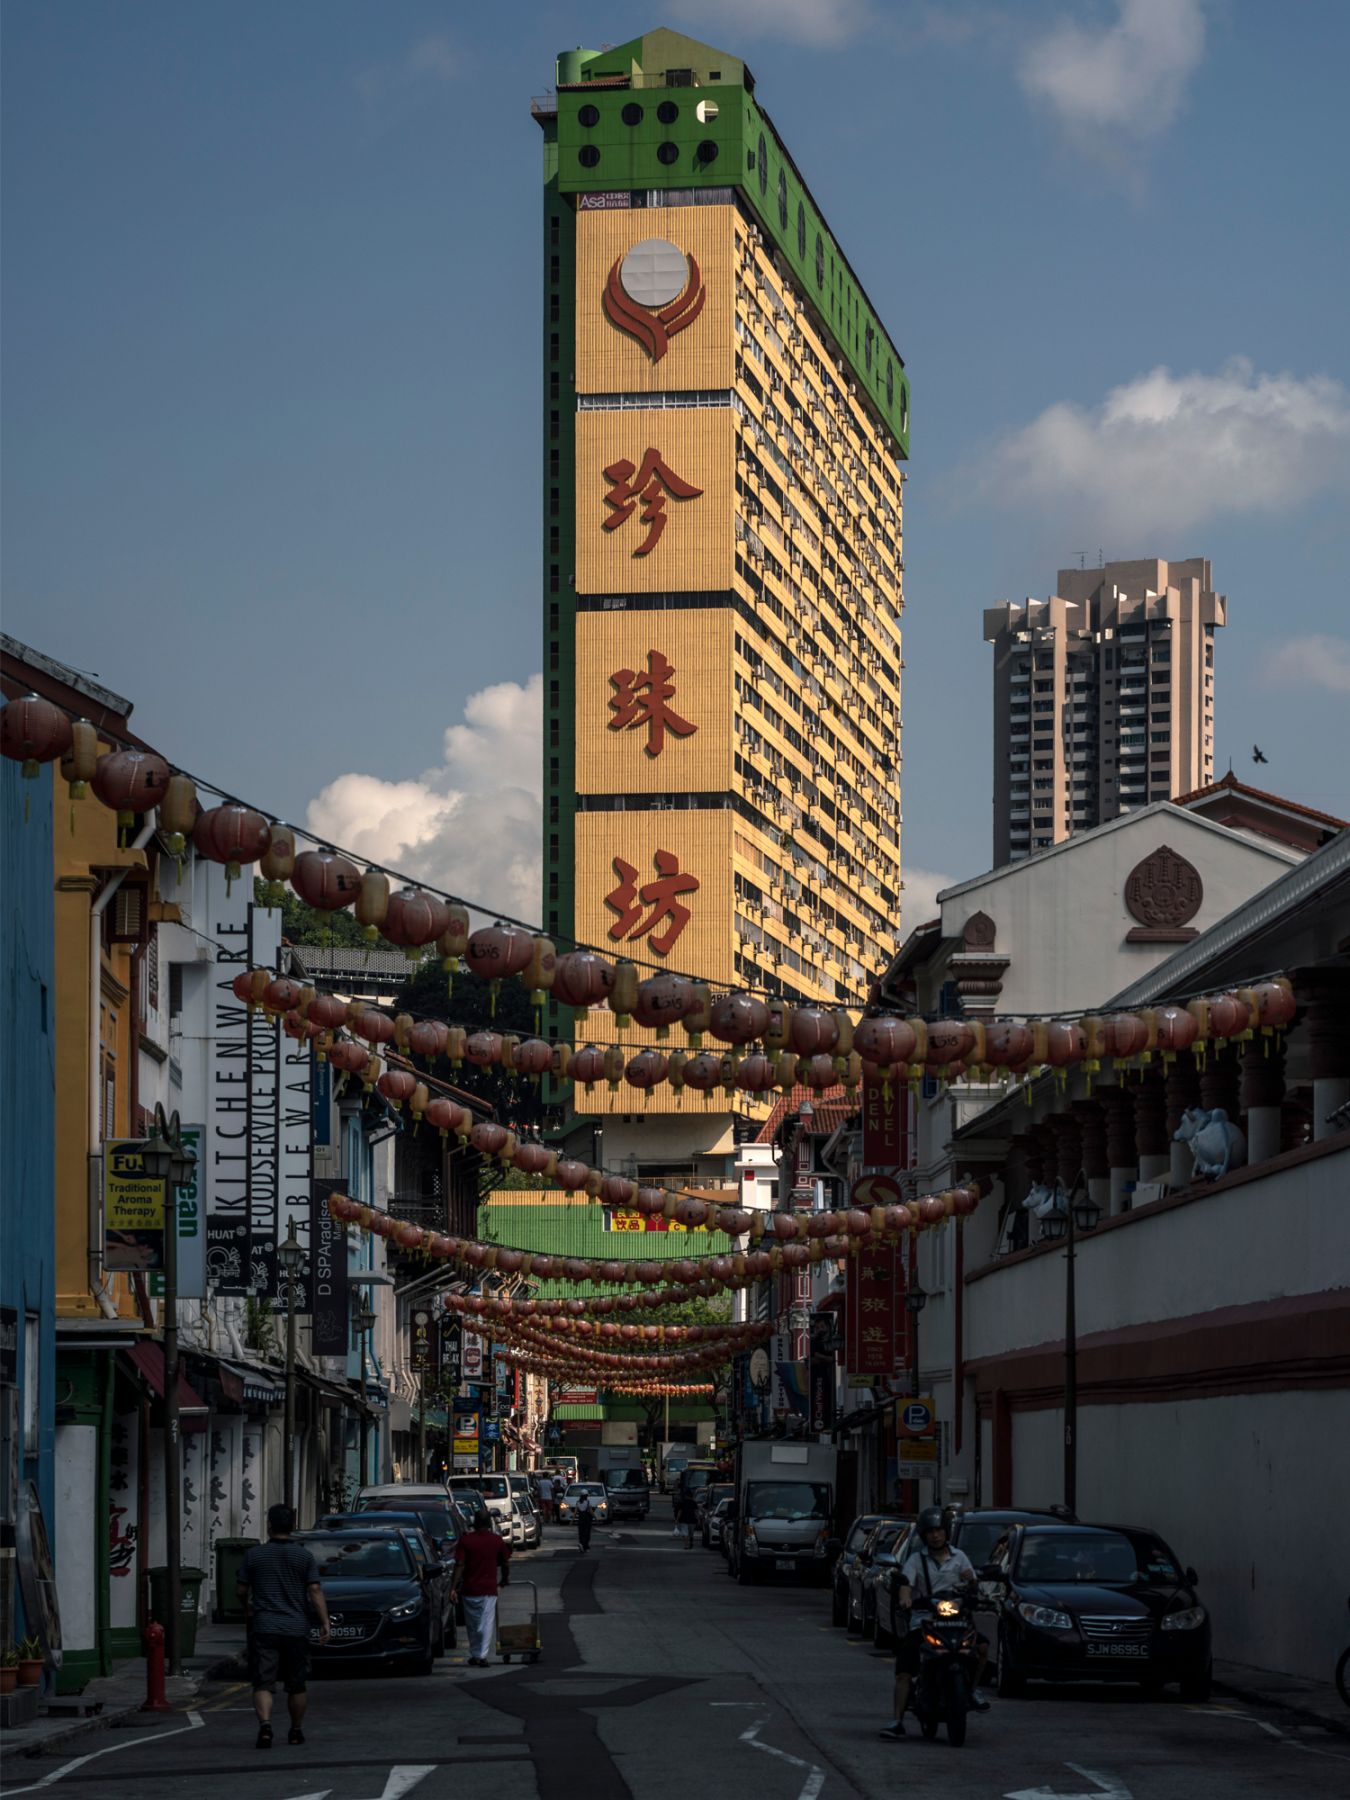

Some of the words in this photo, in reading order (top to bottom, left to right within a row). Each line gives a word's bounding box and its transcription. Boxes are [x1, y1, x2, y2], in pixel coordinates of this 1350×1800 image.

[601, 448, 704, 956] 珍珠坊
[216, 923, 248, 1210] KITCHENWARE
[868, 1087, 880, 1131] DEN
[285, 1031, 312, 1253] ABLEWAR
[114, 1156, 145, 1169] FUJ
[108, 1183, 161, 1193] Traditional
[179, 1131, 200, 1237] krean
[113, 1206, 156, 1217] Therapy
[118, 1195, 152, 1204] Aroma
[207, 1229, 235, 1240] HUAT
[317, 1199, 332, 1276] SPAradise
[251, 1245, 263, 1255] AT
